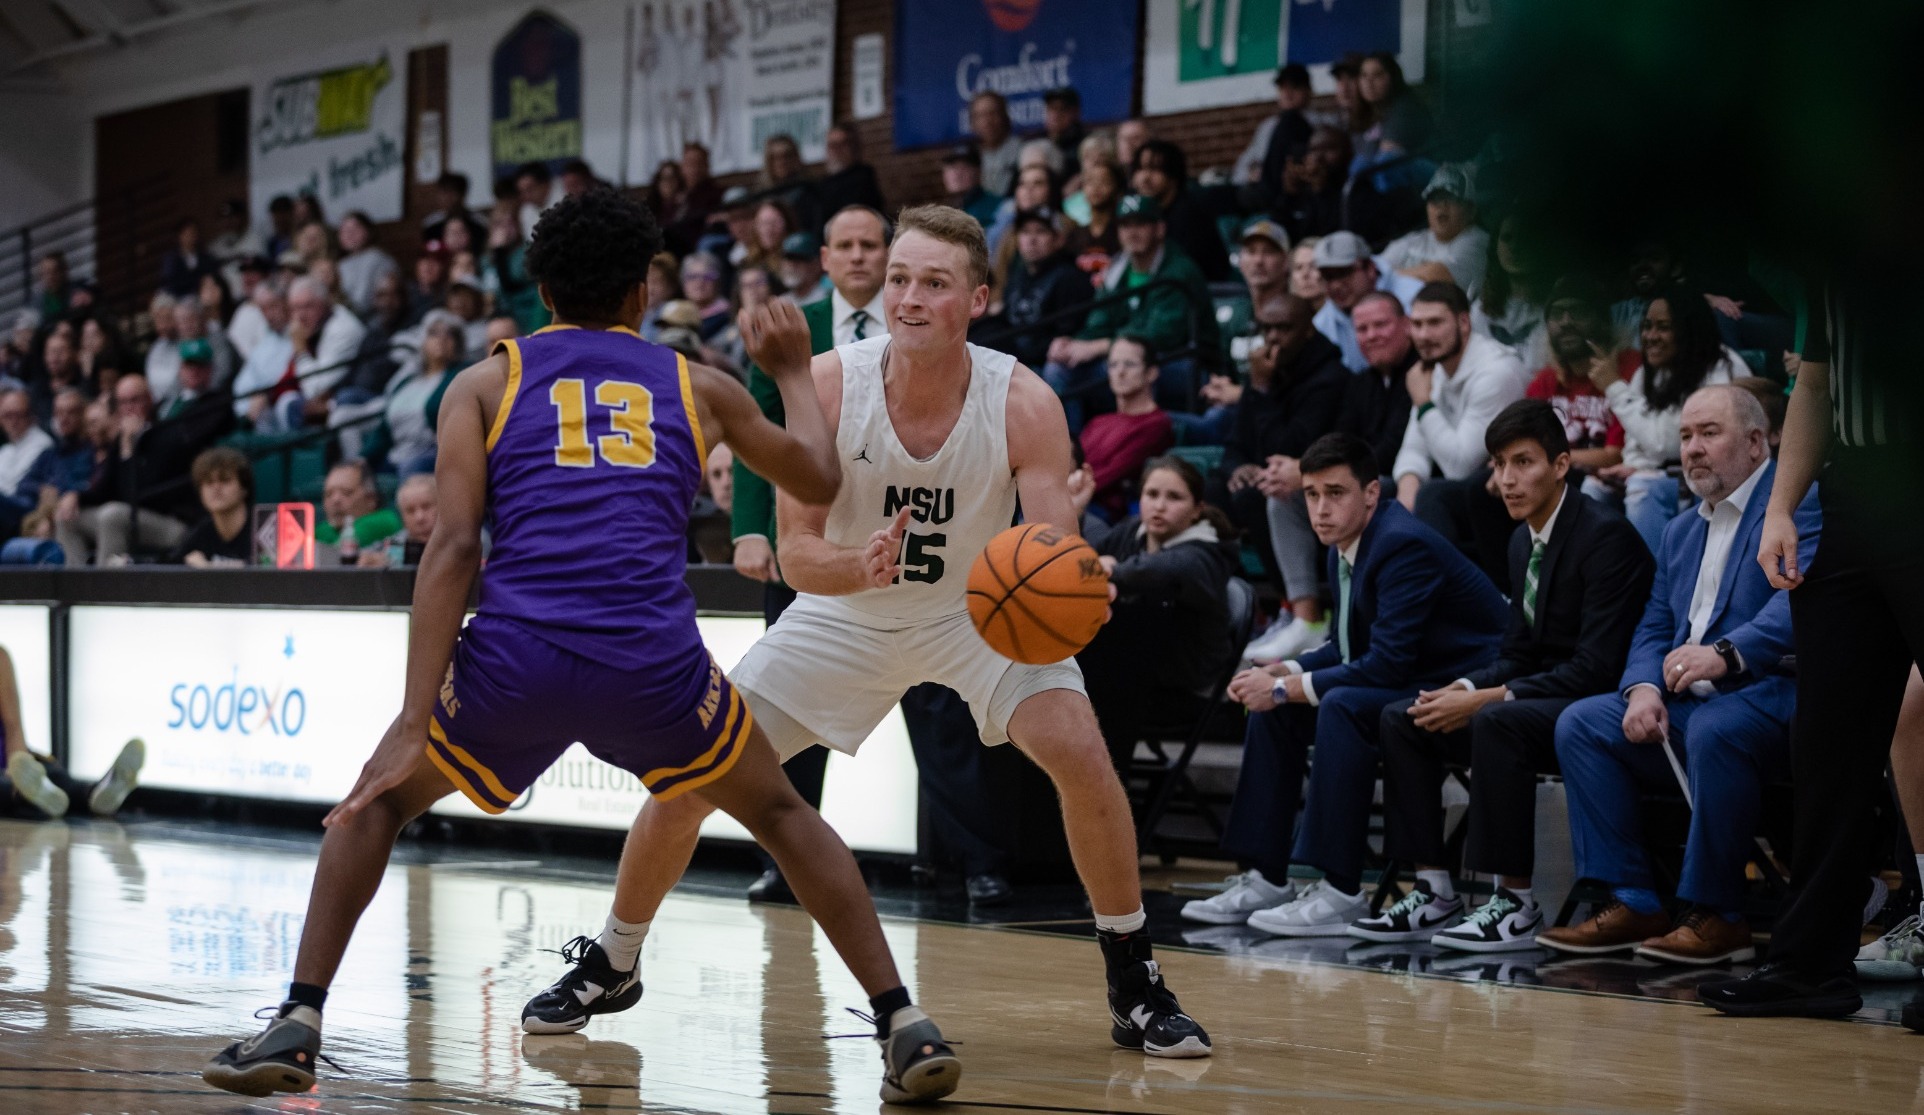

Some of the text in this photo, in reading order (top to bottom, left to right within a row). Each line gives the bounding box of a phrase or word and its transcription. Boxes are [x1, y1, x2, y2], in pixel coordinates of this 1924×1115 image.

[955, 42, 1073, 101] Comfort
[549, 378, 656, 468] 13
[883, 485, 955, 526] NSU
[167, 664, 306, 736] sodexo
